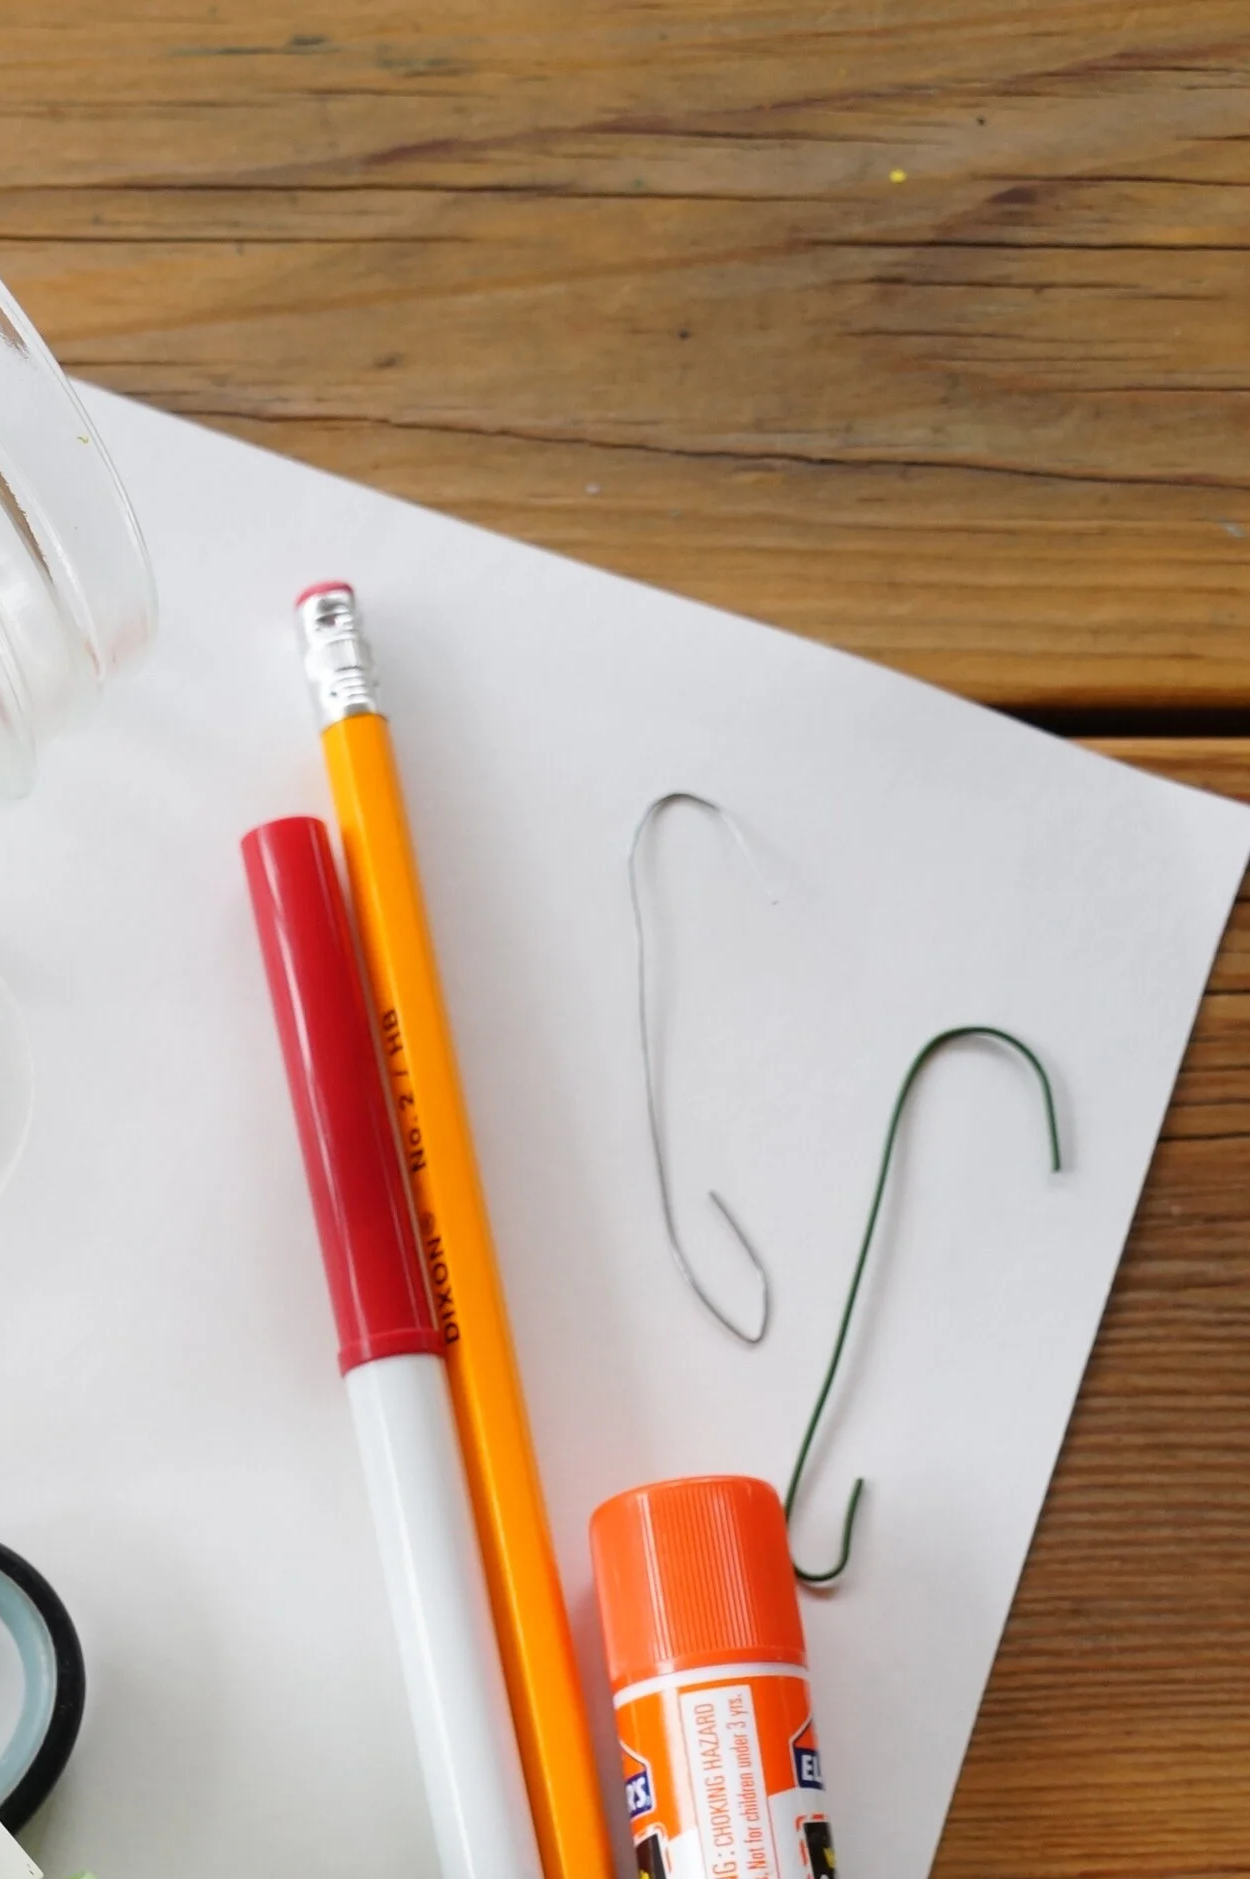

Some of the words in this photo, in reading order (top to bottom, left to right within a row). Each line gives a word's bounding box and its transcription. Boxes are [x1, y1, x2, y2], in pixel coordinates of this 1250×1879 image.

[728, 1694, 748, 1716] yrs.
[693, 1703, 724, 1771] HAZARD
[727, 1721, 746, 1734] 3
[730, 1733, 750, 1768] under
[704, 1775, 734, 1848] CHOKING
[738, 1773, 759, 1821] children
[743, 1822, 762, 1845] for
[747, 1842, 769, 1870] Not
